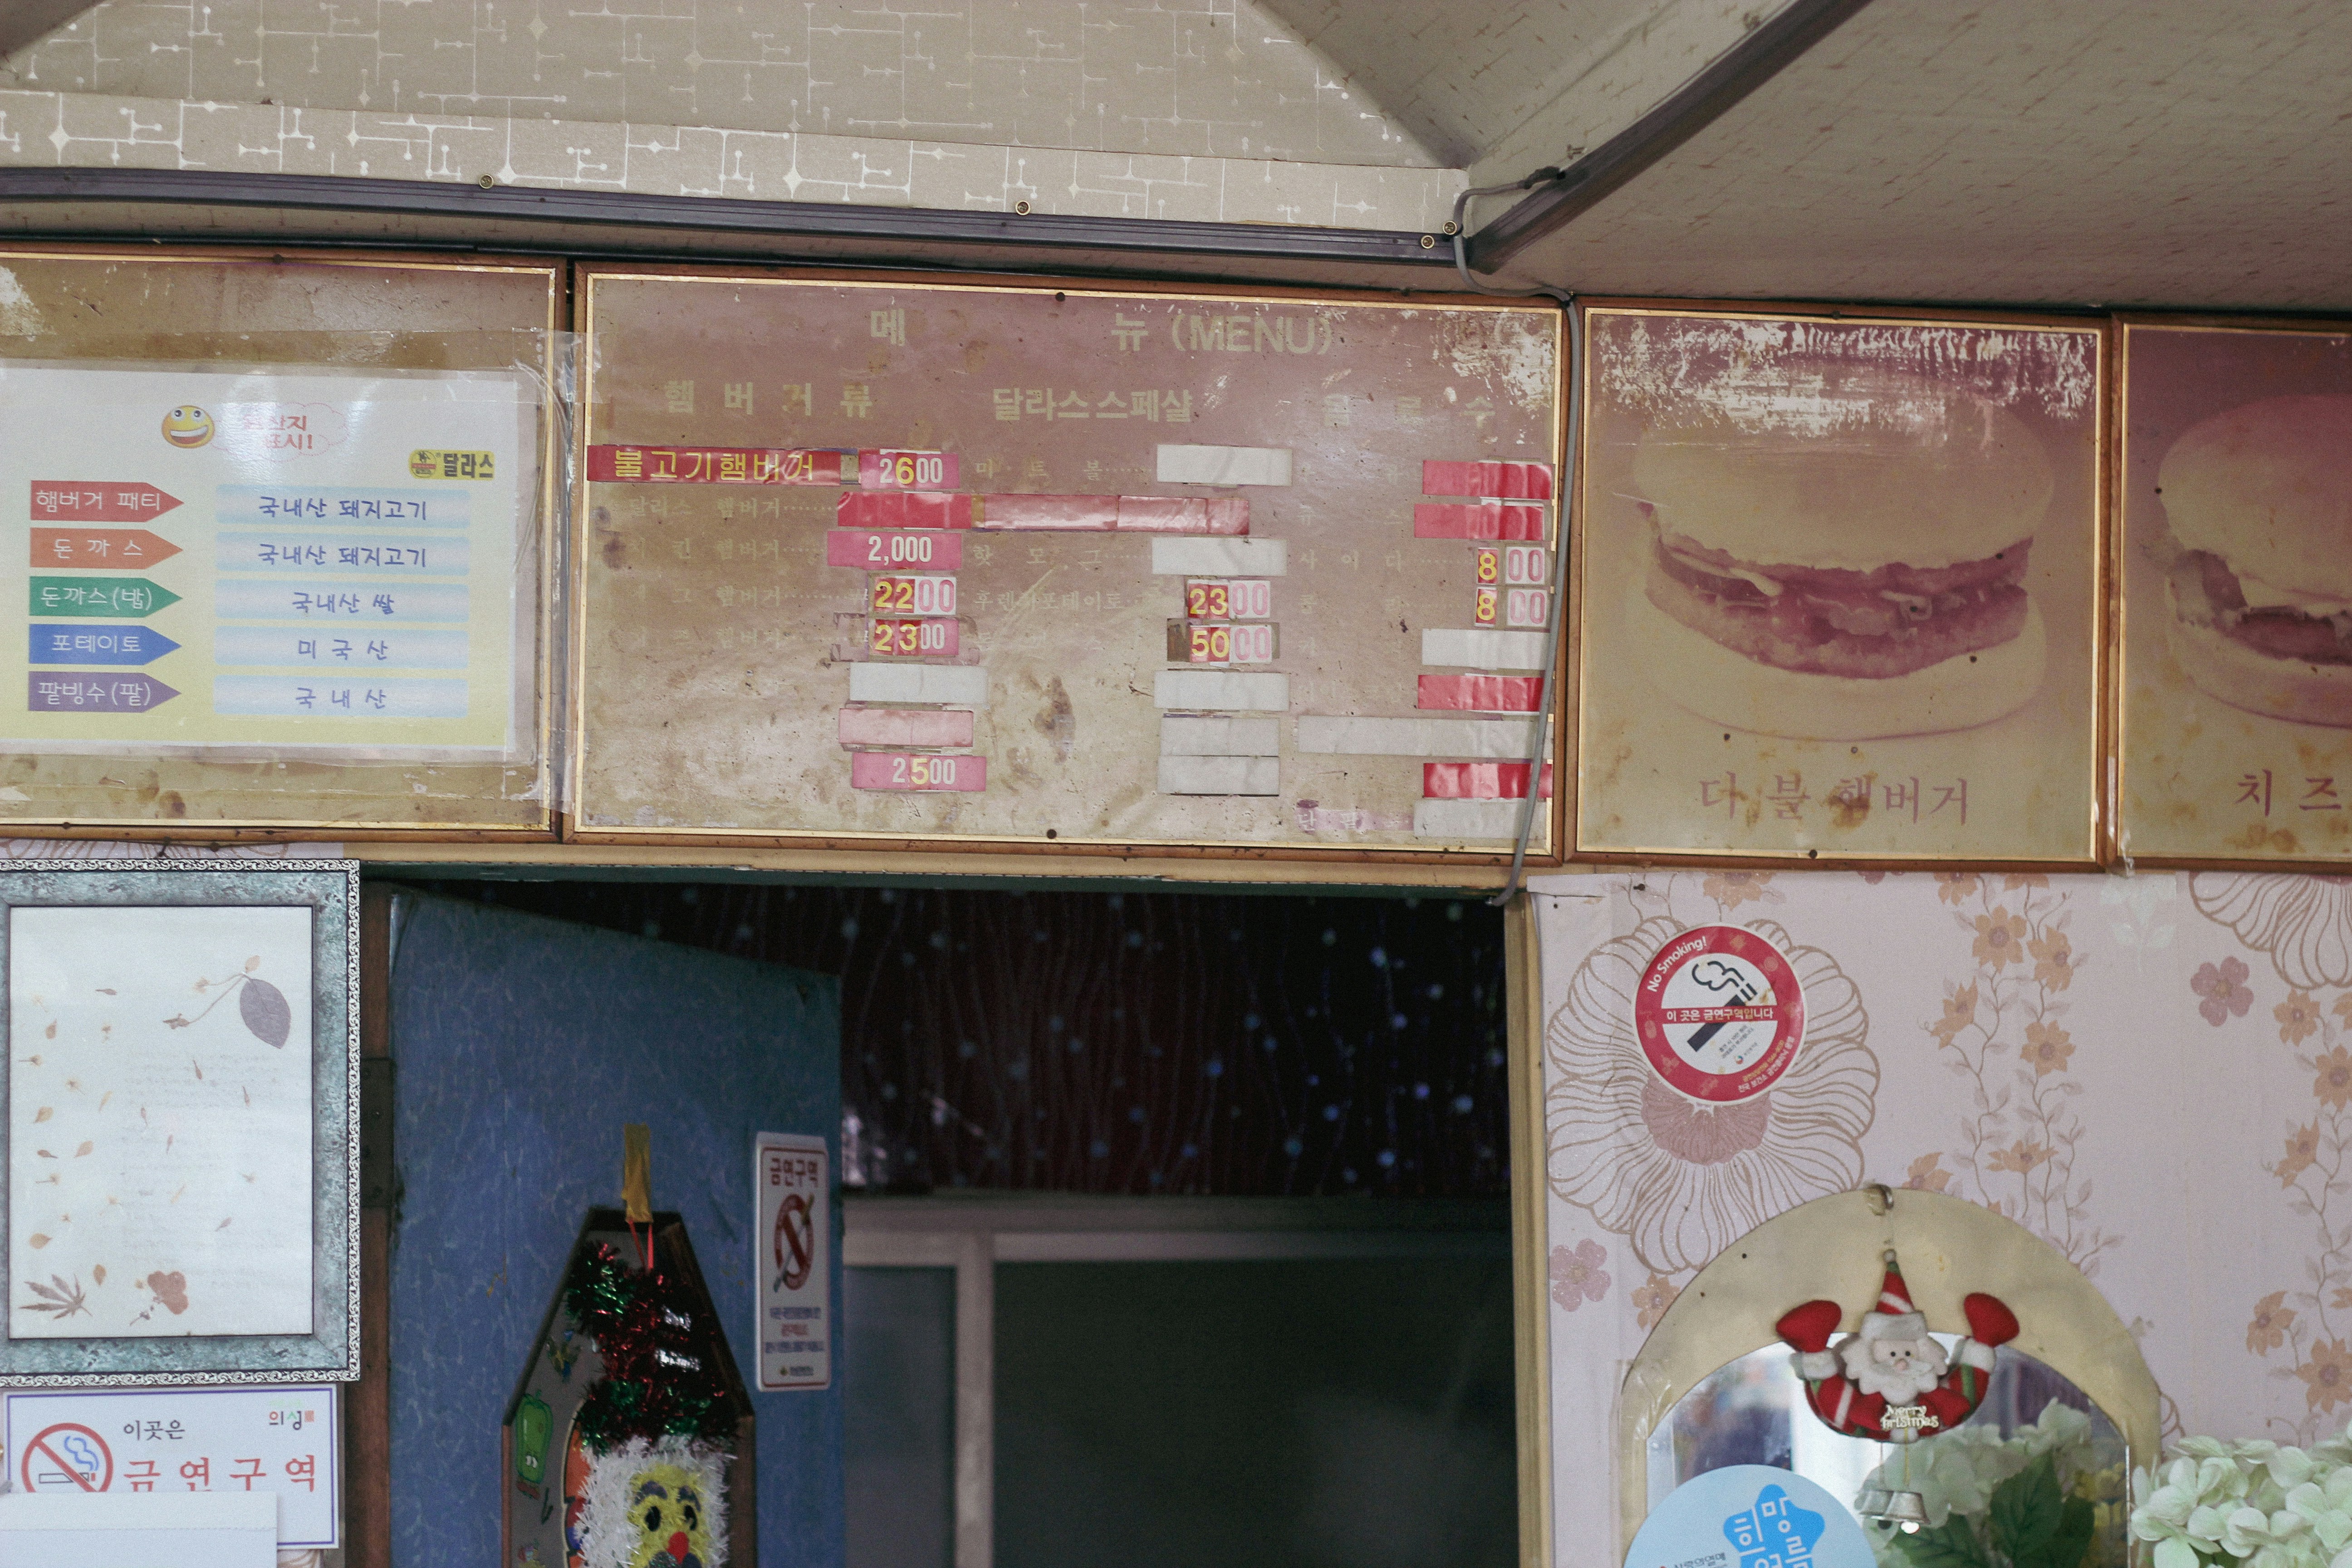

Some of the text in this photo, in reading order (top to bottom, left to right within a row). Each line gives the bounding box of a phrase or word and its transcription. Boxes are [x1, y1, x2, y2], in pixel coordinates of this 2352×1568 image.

[1172, 314, 1333, 353] (MENU)
[444, 453, 494, 478] 달라스
[615, 450, 813, 482] 불고기햄버거
[879, 457, 943, 485] 2600
[36, 490, 161, 513] 햄버거 패티
[259, 496, 426, 520] 국내산 돼지고기
[258, 544, 426, 567] 국내산 돼지고기
[868, 535, 933, 565] 2,000
[41, 587, 152, 610] 돈까스(밥)
[293, 592, 394, 614] 국내산 쌀
[874, 579, 955, 612] 2200
[1189, 583, 1269, 616] 2300
[51, 634, 142, 653] 포테이토
[874, 623, 946, 652] 2300
[1191, 628, 1272, 661] 5000
[38, 681, 151, 706] 팥빙수(팥)
[892, 757, 956, 785] 2500
[1647, 936, 1707, 993] No Smoking!
[1704, 1007, 1774, 1021] 금연구역입니다
[770, 1157, 819, 1188] 금연구역
[123, 1419, 186, 1441] 이곳은
